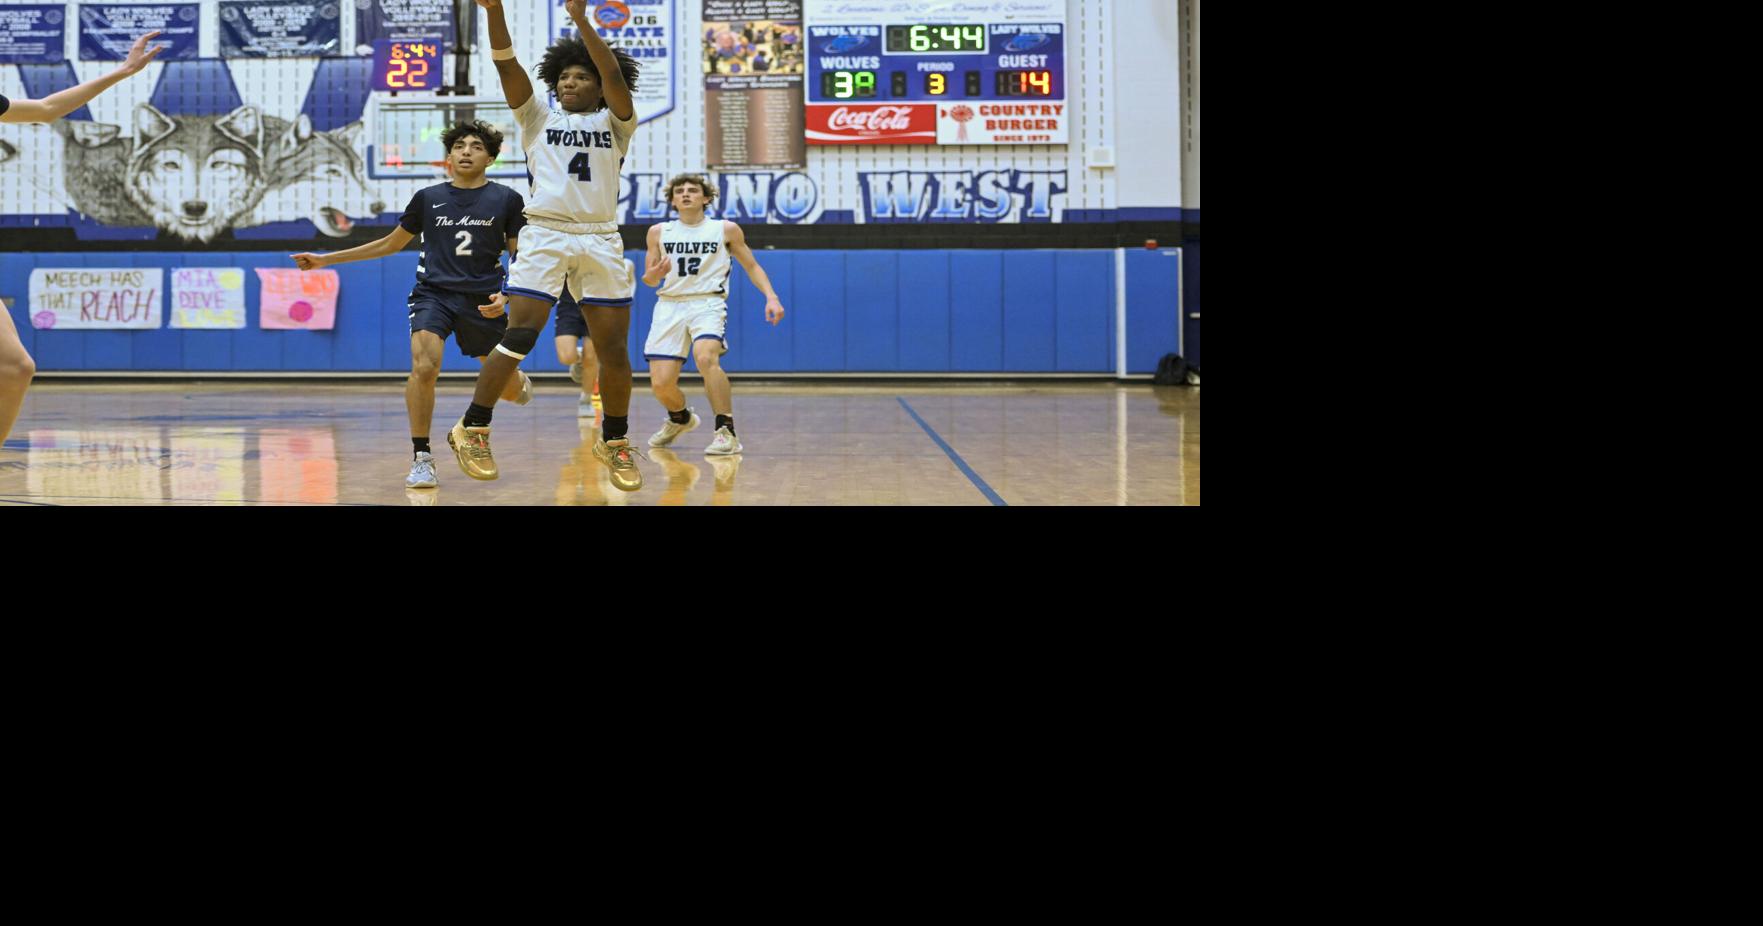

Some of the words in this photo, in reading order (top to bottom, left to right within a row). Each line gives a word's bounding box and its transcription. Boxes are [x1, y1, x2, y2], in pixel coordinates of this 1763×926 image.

[596, 27, 663, 38] STATE
[810, 26, 879, 37] WOLVES
[909, 25, 983, 51] 6:44
[391, 43, 436, 60] 6:44
[820, 55, 881, 70] WOLVES
[916, 61, 955, 72] PERIOD
[998, 54, 1049, 68] GUEST
[386, 59, 428, 87] 22
[929, 73, 945, 95] 3
[1020, 71, 1050, 95] 14
[827, 106, 913, 131] Coca-Cola
[979, 104, 1064, 117] COUNTRY
[985, 119, 1058, 131] BURGER
[546, 128, 612, 149] WOLVES
[993, 134, 1024, 142] SINCE
[568, 151, 591, 182] 4
[857, 169, 1068, 220] WEST
[435, 215, 454, 227] The
[455, 215, 495, 227] Mound
[455, 230, 473, 256] 2
[663, 241, 719, 255] WOLVES
[677, 257, 702, 277] 12
[44, 271, 102, 288] MEECH
[109, 270, 145, 288] HAS
[39, 291, 75, 310] THAT
[80, 287, 156, 323] REACH
